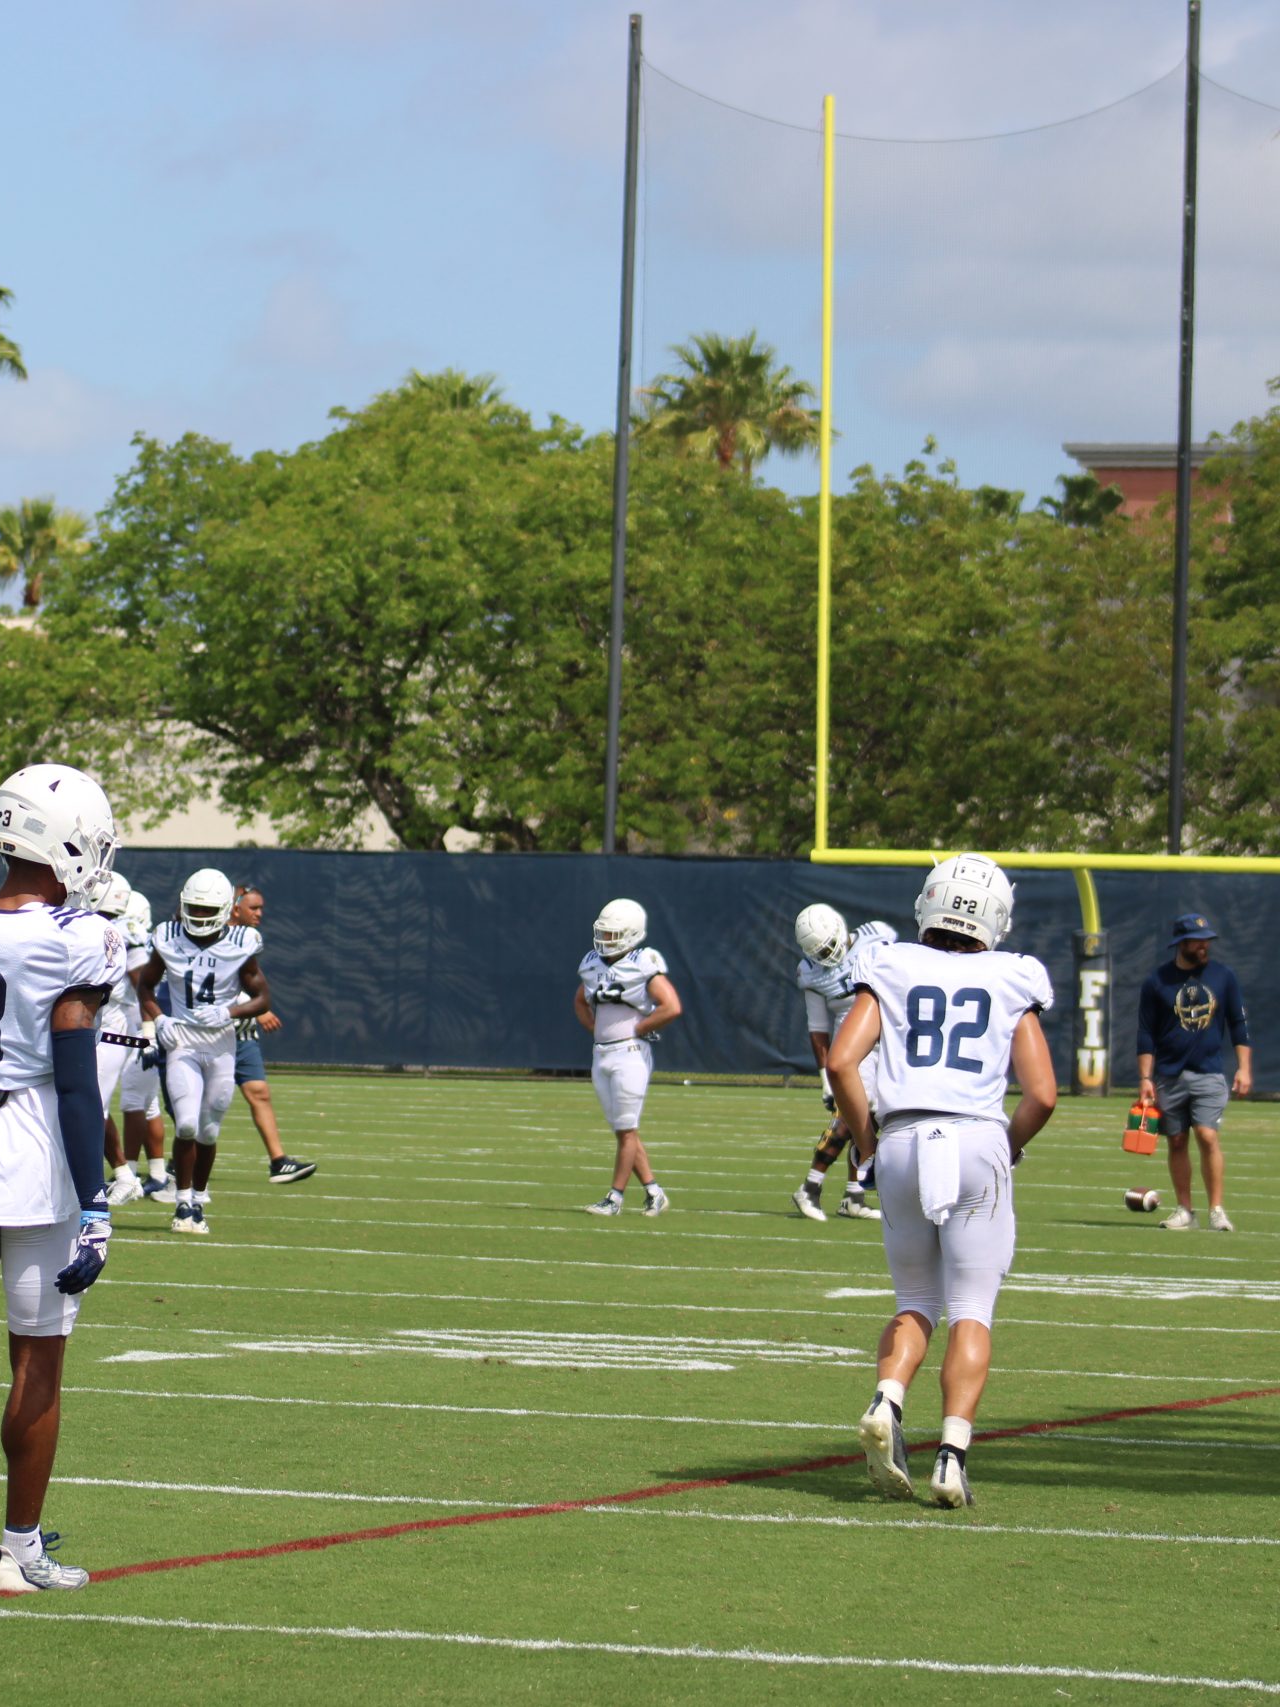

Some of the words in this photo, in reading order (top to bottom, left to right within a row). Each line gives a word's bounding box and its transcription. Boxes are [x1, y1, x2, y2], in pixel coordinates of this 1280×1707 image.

[184, 970, 216, 1009] 14
[187, 956, 217, 967] FIU
[906, 984, 991, 1074] 82
[1077, 970, 1108, 1088] FIU
